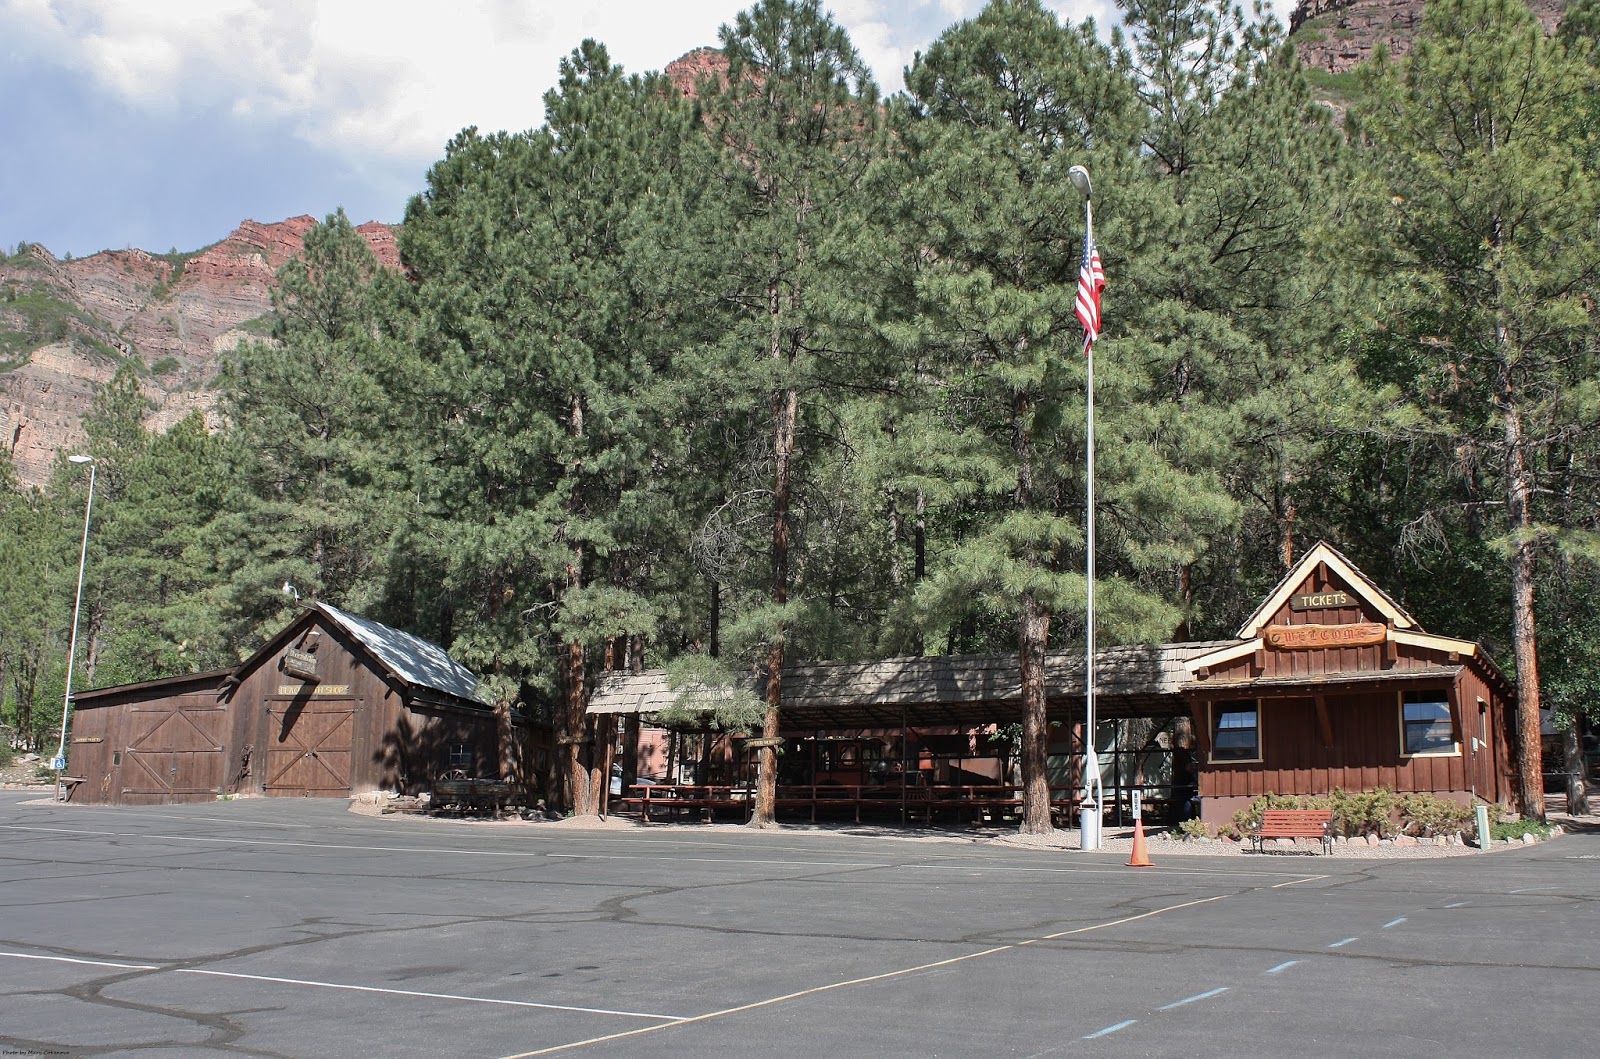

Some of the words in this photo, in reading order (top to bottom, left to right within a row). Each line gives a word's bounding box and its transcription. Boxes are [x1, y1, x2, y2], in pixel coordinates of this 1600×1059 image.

[1301, 593, 1347, 607] TICKETS
[1283, 628, 1366, 642] WELCOME
[325, 686, 344, 694] SHOP
